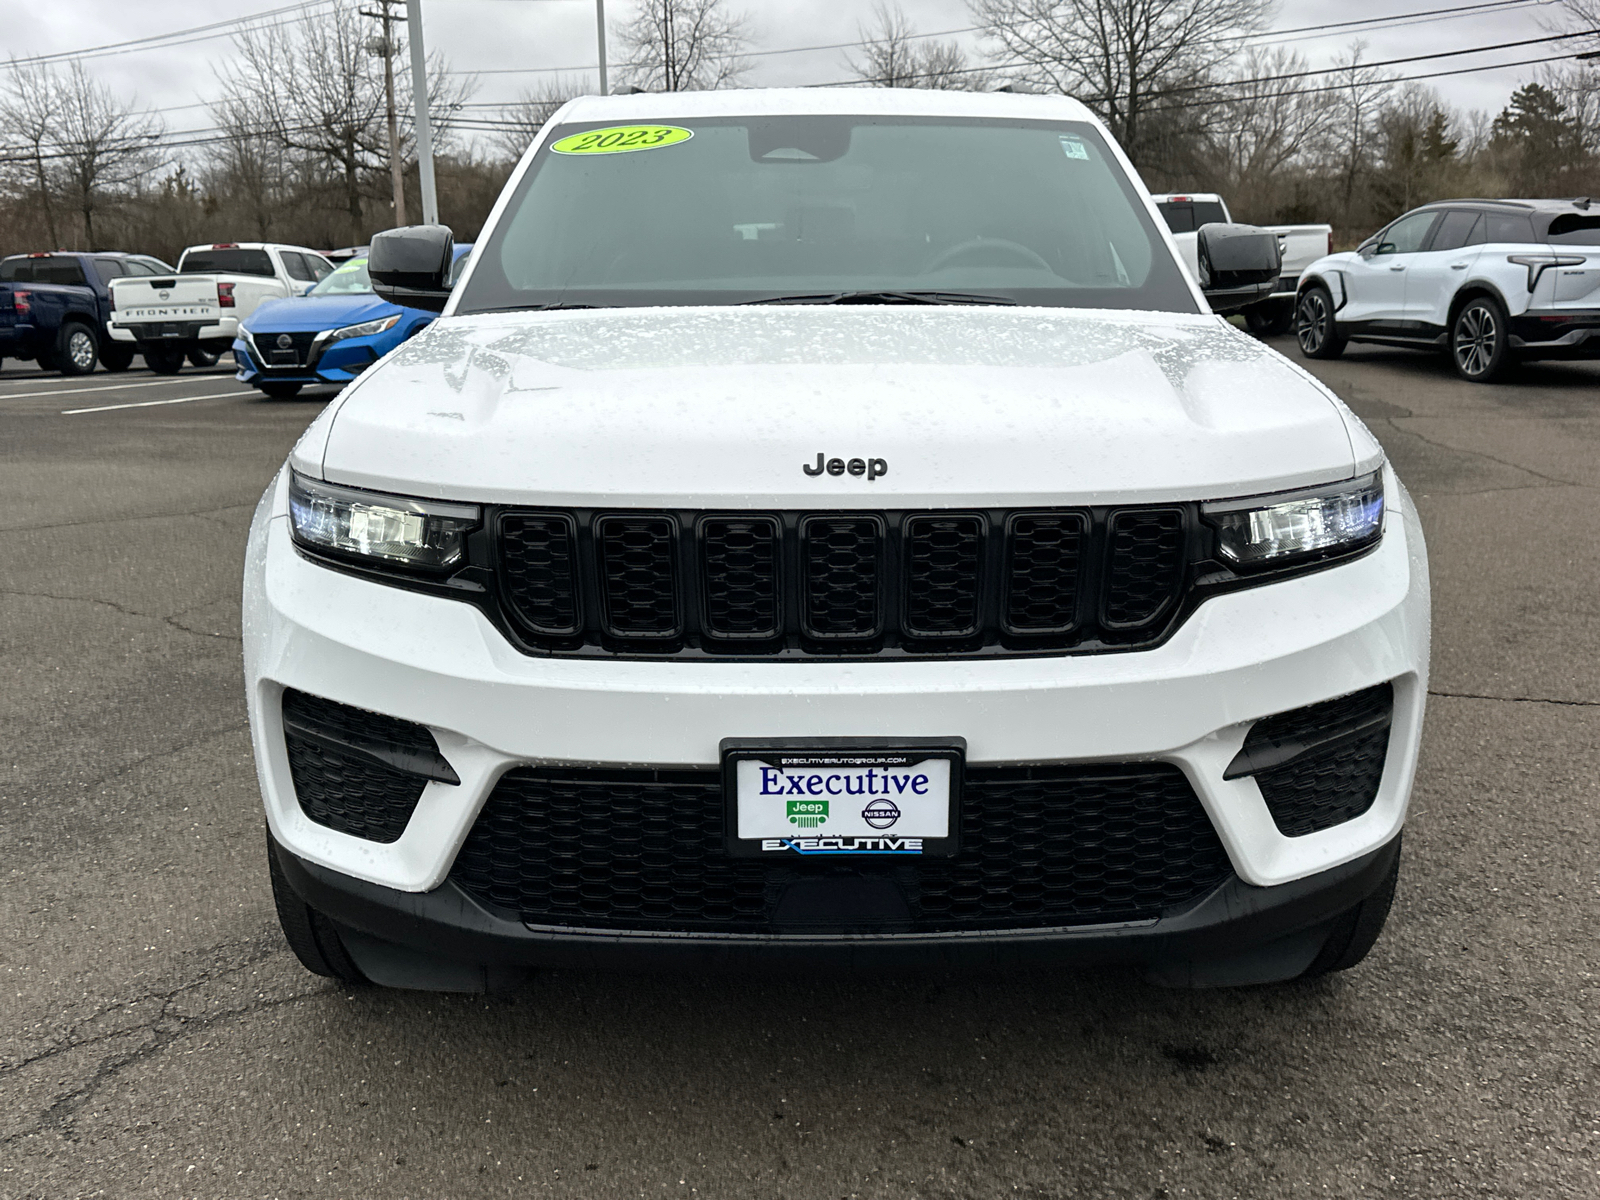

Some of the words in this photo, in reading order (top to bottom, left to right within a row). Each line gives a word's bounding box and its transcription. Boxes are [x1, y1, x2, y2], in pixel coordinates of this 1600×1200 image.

[571, 129, 673, 151] 2023
[125, 308, 209, 316] FRONTIER
[803, 452, 888, 481] Jeep
[759, 766, 929, 795] Executive
[792, 802, 824, 813] Jeep
[762, 838, 924, 852] EXECUTIVE
